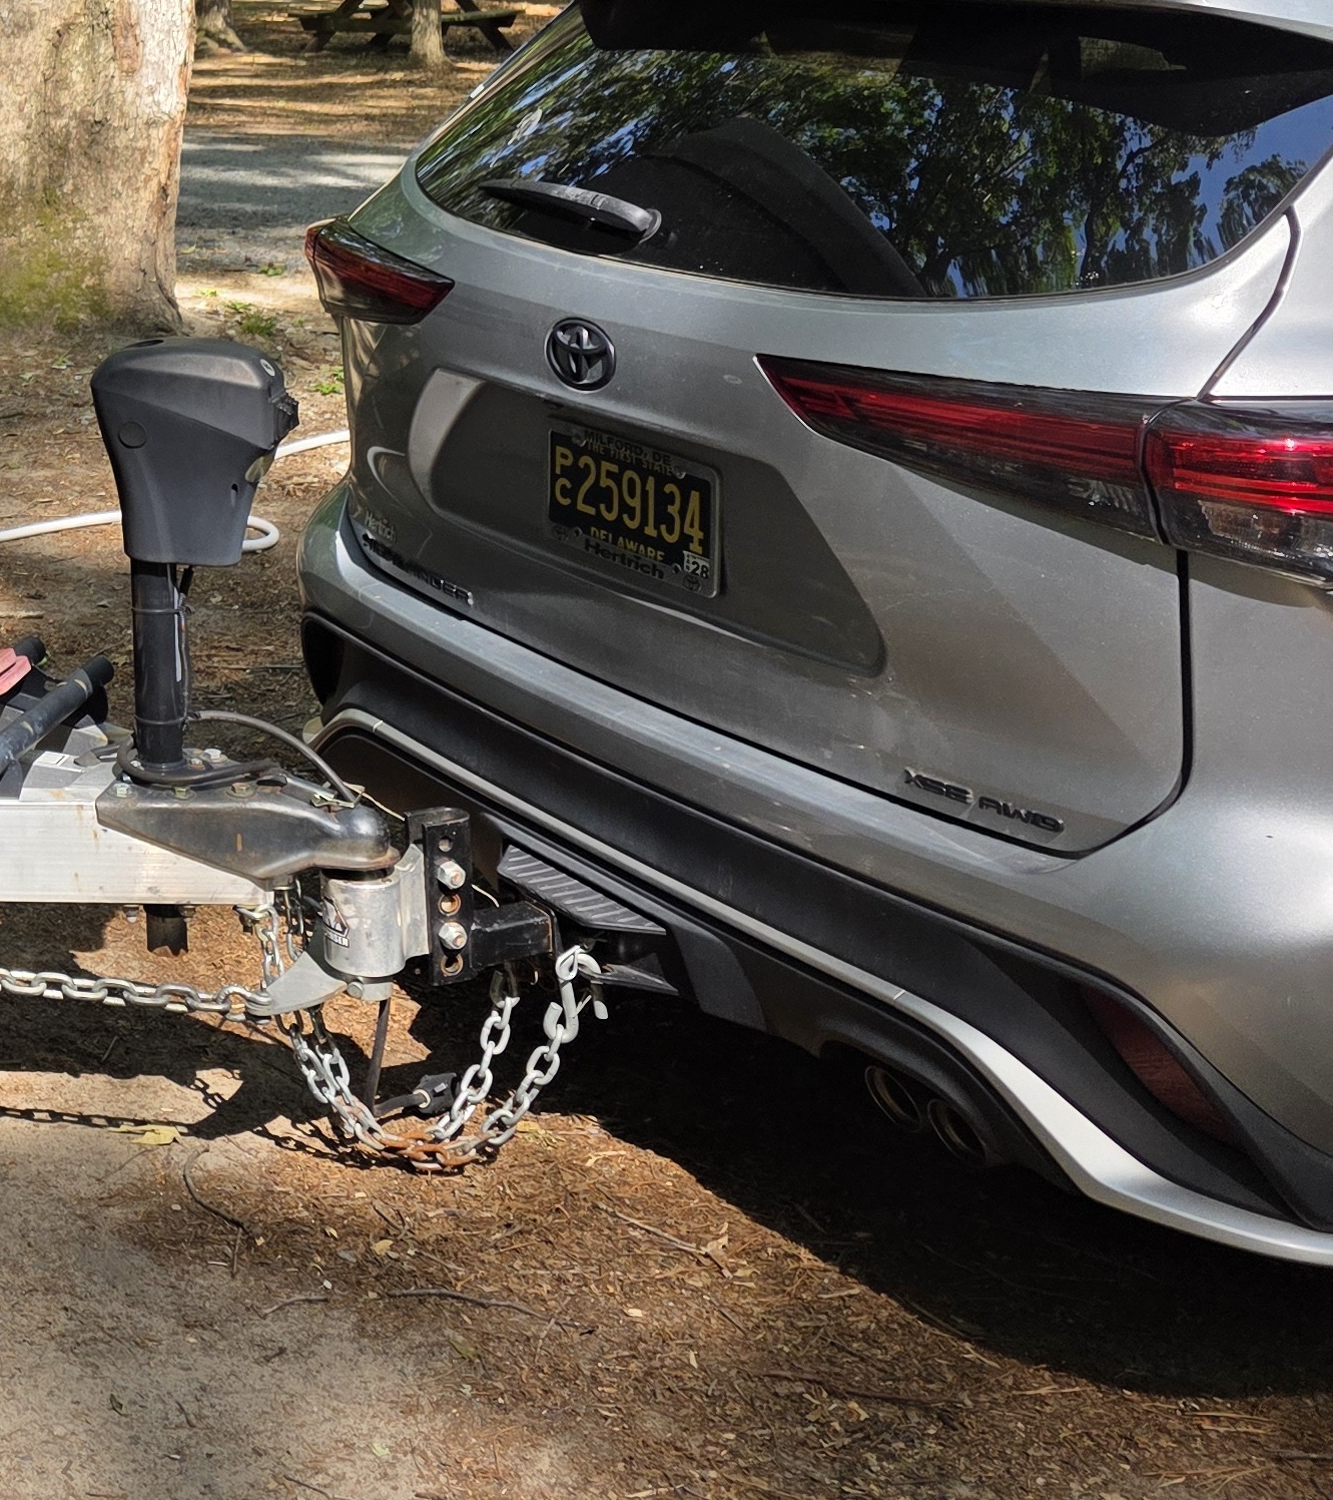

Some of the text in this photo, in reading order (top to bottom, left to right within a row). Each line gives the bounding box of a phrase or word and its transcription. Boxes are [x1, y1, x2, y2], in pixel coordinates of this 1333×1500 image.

[576, 455, 705, 556] 259134
[585, 539, 665, 580] Hertrich
[590, 526, 665, 562] DELAWARE
[979, 796, 1065, 833] AWD
